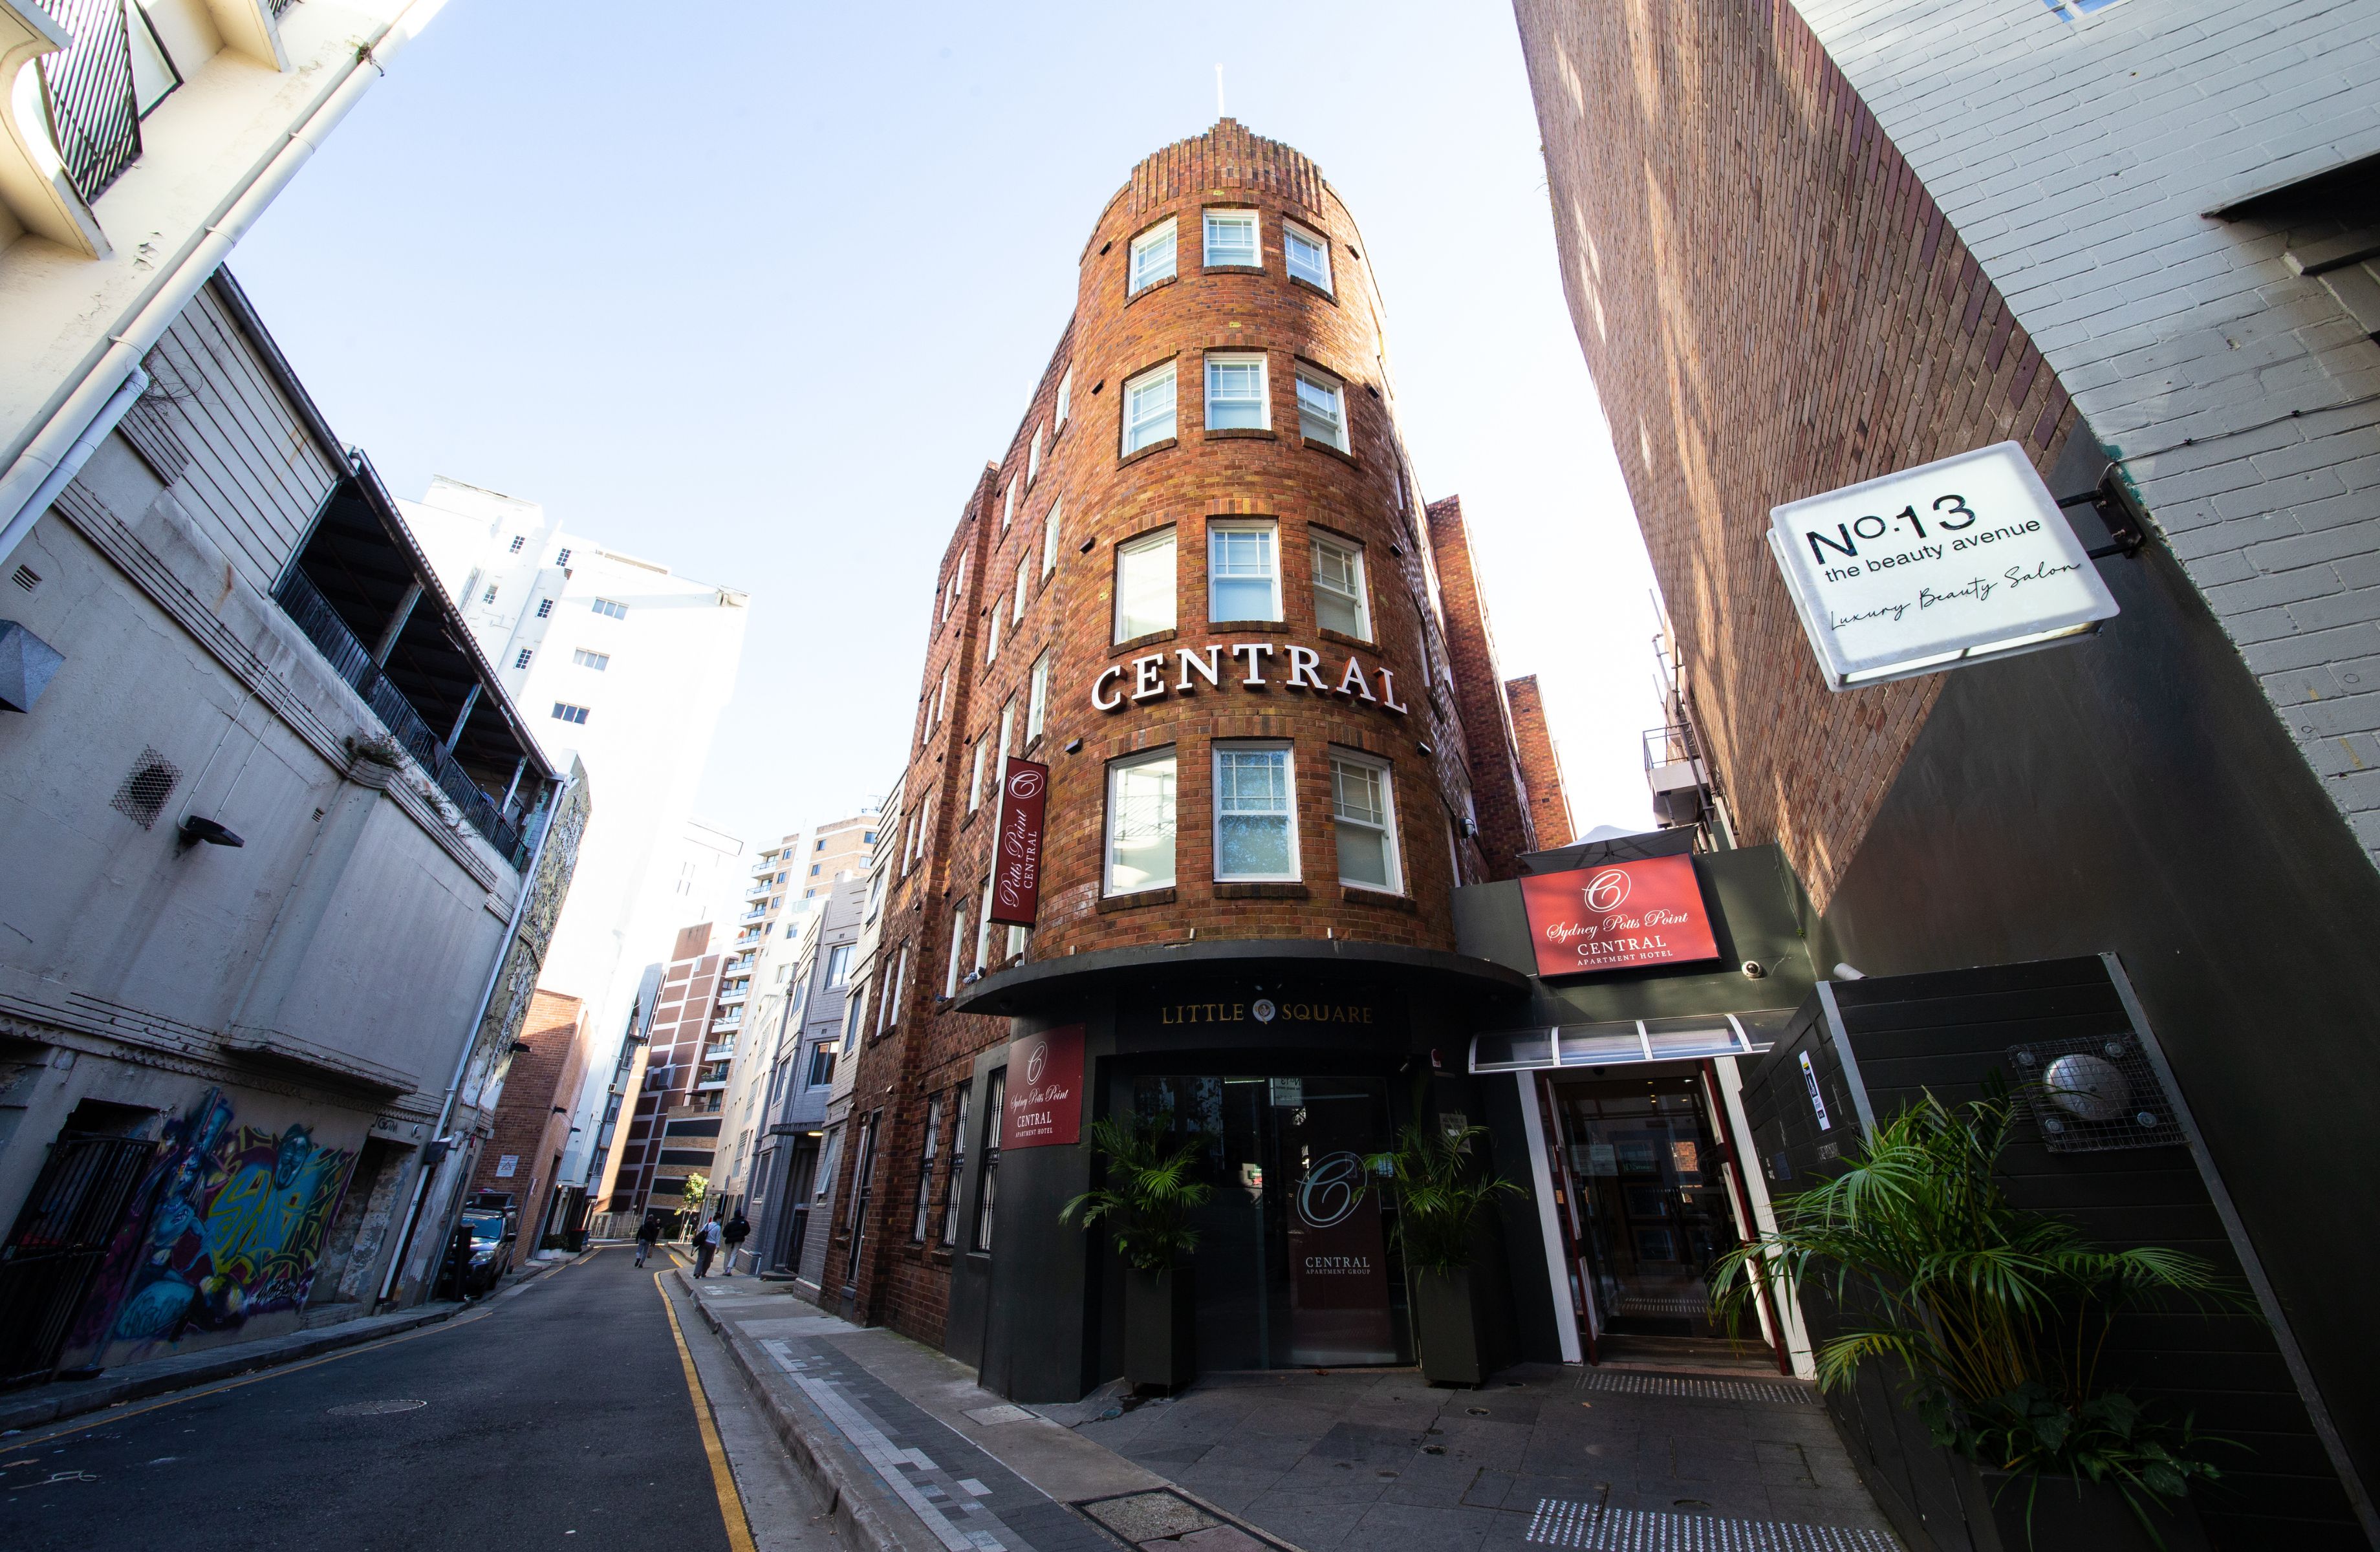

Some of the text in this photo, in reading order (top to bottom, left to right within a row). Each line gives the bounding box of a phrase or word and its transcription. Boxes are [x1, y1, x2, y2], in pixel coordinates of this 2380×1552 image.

[1824, 519, 2041, 583] the beauty avenue
[1830, 562, 2081, 631] Luxury Beauty Salon
[1091, 643, 1407, 715] CENTRAL
[1000, 809, 1027, 908] Potts Point
[1024, 830, 1037, 889] CENTRAL
[1546, 909, 1689, 943] Sydney Potts Point
[1577, 935, 1667, 956] CENTRAL
[1577, 949, 1673, 965] APARTMENT HOTEL
[1162, 1004, 1373, 1024] LITTLE SQUARE
[1010, 1084, 1068, 1114] Sydney Potts Point
[1015, 1127, 1053, 1137] APARTMENT HOTEL
[1017, 1111, 1052, 1128] CENTRAL
[1305, 1257, 1370, 1267] CENTRAL
